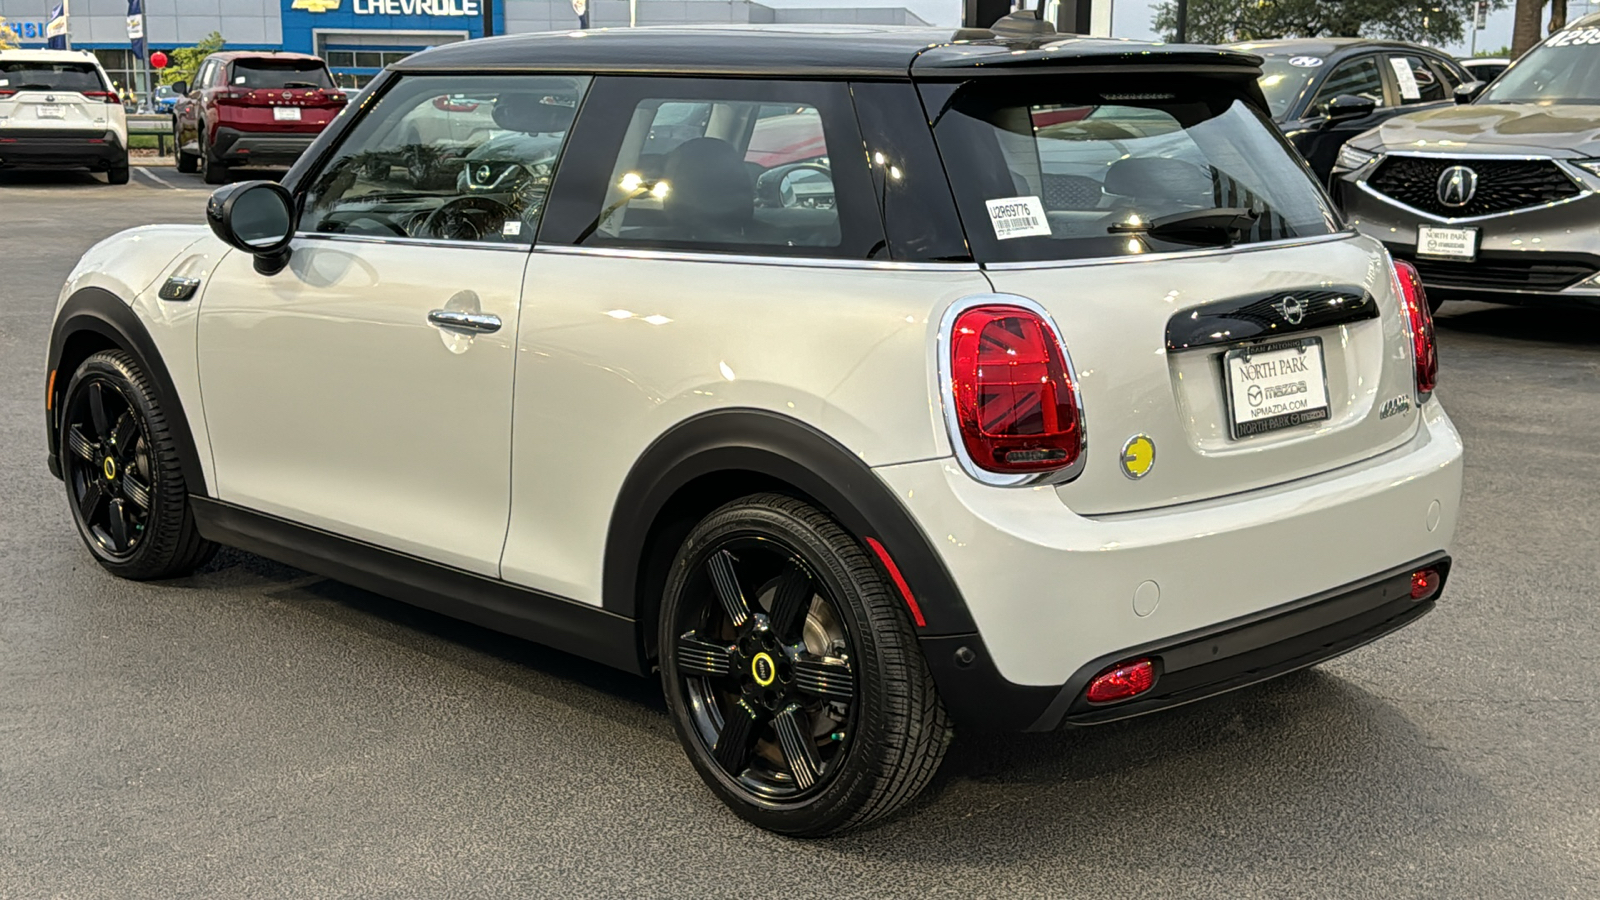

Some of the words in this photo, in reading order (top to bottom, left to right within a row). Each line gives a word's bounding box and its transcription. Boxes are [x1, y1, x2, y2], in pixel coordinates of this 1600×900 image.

[353, 0, 483, 15] CHEVROLE
[990, 204, 1031, 219] U2R69776
[1239, 361, 1277, 382] NORTH
[1279, 356, 1308, 376] PARK
[1251, 399, 1308, 418] NPMAZDA.COM
[1240, 420, 1268, 435] NORTH
[1269, 415, 1290, 429] PARK
